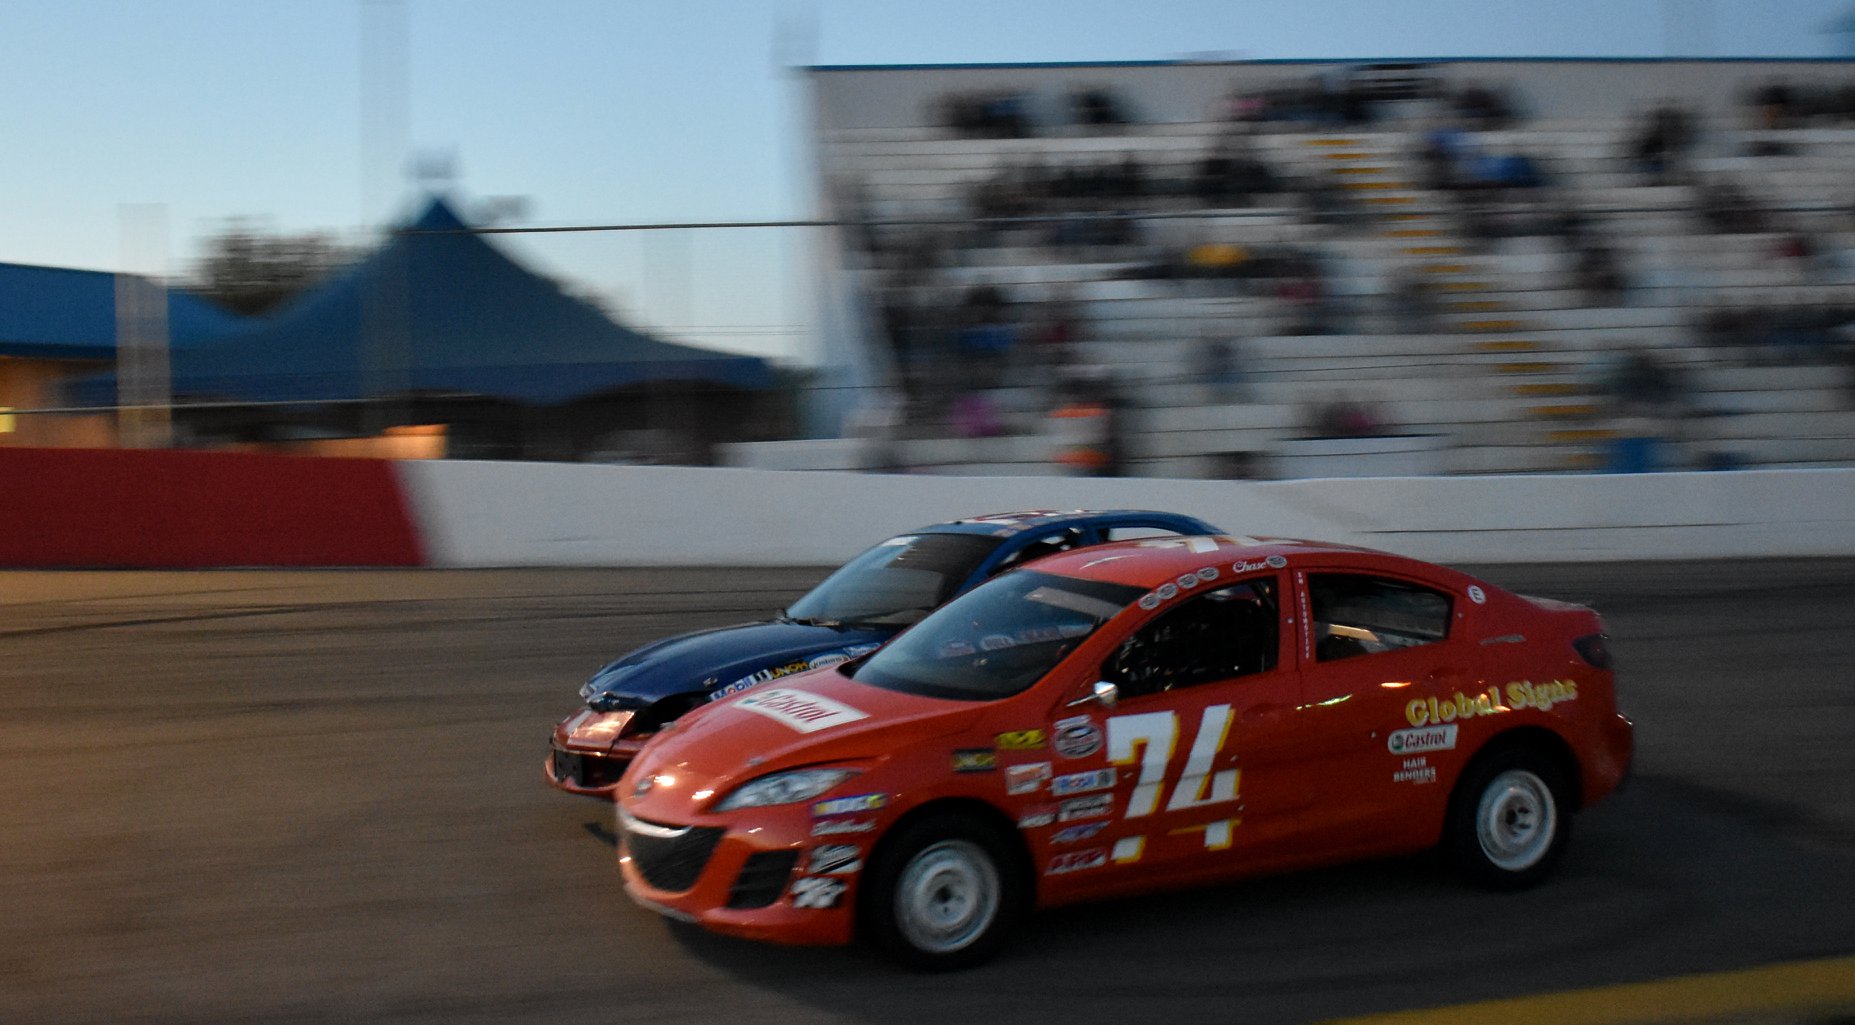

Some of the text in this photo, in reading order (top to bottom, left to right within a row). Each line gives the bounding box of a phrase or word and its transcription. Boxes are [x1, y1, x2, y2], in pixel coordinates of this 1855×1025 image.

[1233, 561, 1267, 573] Chase
[1405, 679, 1578, 727] Global Signs
[1404, 730, 1447, 749] Castrol
[1403, 756, 1427, 769] HAIR
[1106, 703, 1242, 865] 74
